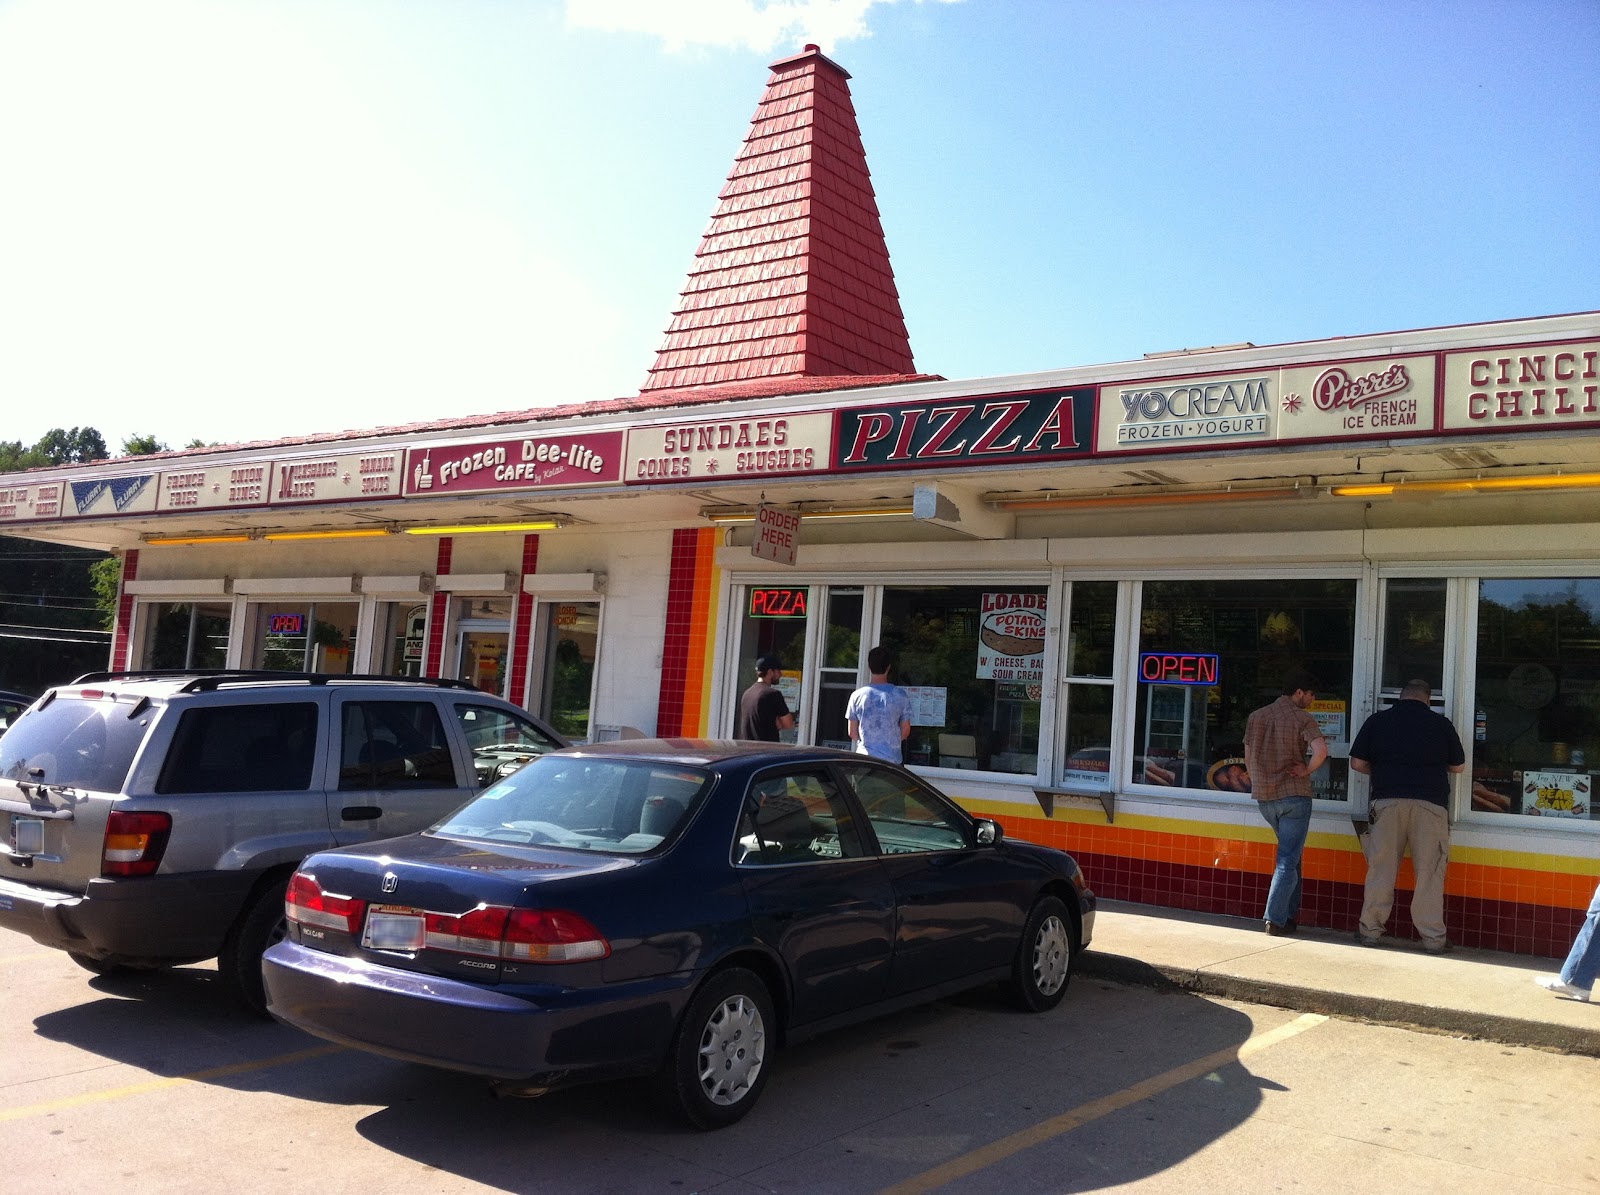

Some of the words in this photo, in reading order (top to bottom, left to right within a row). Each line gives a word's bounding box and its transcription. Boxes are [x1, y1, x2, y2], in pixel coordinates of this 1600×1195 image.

[1312, 364, 1409, 411] Pierre's
[1119, 380, 1268, 422] YOCREAM
[1364, 399, 1417, 415] FRENCH
[1468, 385, 1598, 420] CHILI
[843, 396, 1080, 464] PIZZA
[1119, 422, 1185, 441] FROZEN
[1196, 417, 1266, 437] YOGURT
[1343, 415, 1364, 429] ICE
[1370, 413, 1417, 427] CREAM
[663, 420, 788, 454] SUNDAES
[360, 454, 394, 473] BANANA
[440, 447, 506, 485] Frozen
[521, 440, 604, 474] Dee-lite
[494, 463, 536, 481] CAFE
[637, 457, 691, 478] CONES
[736, 448, 813, 472] SLUSHES
[166, 471, 205, 489] FRENCH
[231, 466, 264, 483] ONION
[77, 481, 102, 513] FLURRY
[115, 478, 141, 509] FLURRY
[169, 489, 198, 506] FRIES
[229, 484, 261, 501] RINGS
[760, 509, 799, 532] ORDER
[761, 527, 793, 548] HERE
[752, 590, 806, 615] PIZZA
[272, 616, 300, 632] OPEN
[996, 615, 1042, 627] POTATO
[994, 657, 1027, 669] CHEESE,
[1143, 655, 1216, 682] OPEN
[992, 669, 1014, 680] SOUR
[1551, 774, 1574, 784] NEW
[1535, 799, 1575, 811] CLAW
[1537, 788, 1574, 800] BEAR
[458, 959, 497, 970] ACCORD
[504, 965, 519, 973] LX
